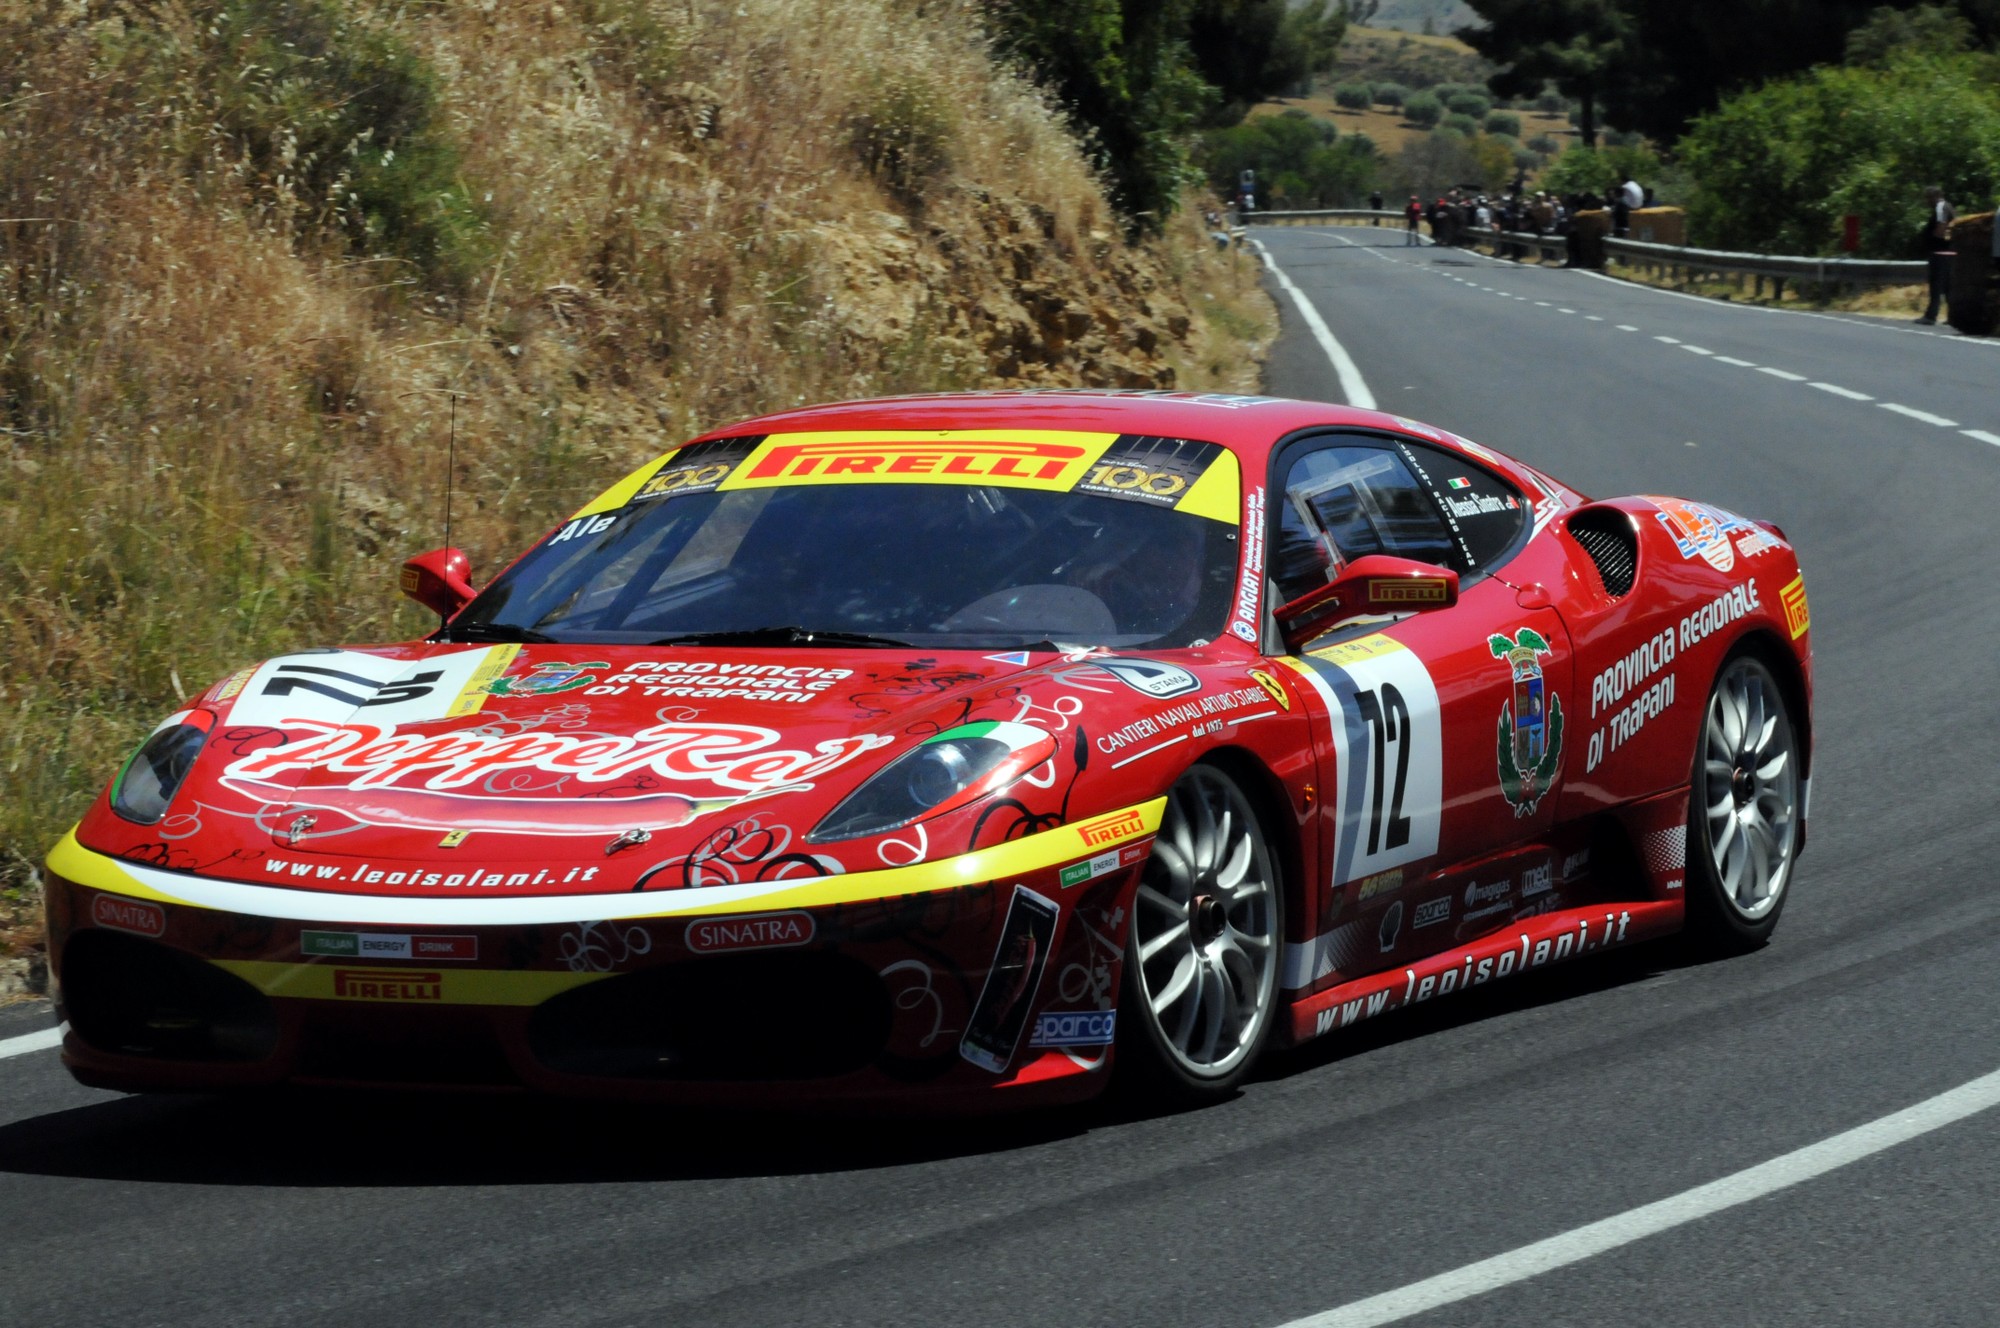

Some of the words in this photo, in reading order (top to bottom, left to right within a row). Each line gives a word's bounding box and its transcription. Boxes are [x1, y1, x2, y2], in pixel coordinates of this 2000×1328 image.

[745, 440, 1086, 480] PIRELLI
[643, 464, 731, 495] 100
[1080, 483, 1111, 493] YEARS
[1123, 490, 1174, 503] VICTORIES
[1089, 465, 1187, 495] 100
[1433, 491, 1460, 532] RACING
[1458, 537, 1476, 566] TEAM
[1372, 582, 1444, 599] PIRELLI
[1592, 626, 1675, 719] PROVINCIA
[1679, 577, 1760, 652] REGIONALE
[604, 673, 837, 691] REGIONALE
[623, 661, 854, 680] PROVINCIA
[1149, 675, 1189, 691] STAMA
[261, 665, 446, 708] 72
[583, 685, 630, 696] DI
[643, 685, 816, 703] TRAPANI
[1096, 717, 1160, 754] CANTIERI
[1155, 702, 1202, 729] NAVALI
[1201, 692, 1239, 716] ARTURO
[1234, 686, 1269, 706] STABILE
[1192, 723, 1206, 738] dal
[1205, 718, 1224, 735] 1875
[1586, 726, 1605, 774] DI
[1610, 673, 1675, 752] TRAPANI
[1353, 682, 1411, 857] 72
[1077, 810, 1144, 847] PIRELLI
[265, 858, 600, 887] www.leoisolani.it
[1065, 866, 1089, 881] ITALIAN
[1093, 857, 1117, 872] ENERGY
[1124, 848, 1141, 860] DRINK
[100, 900, 157, 930] SINATRA
[1415, 899, 1450, 923] sparco
[316, 937, 354, 949] ITALIAN
[363, 940, 406, 951] ENERGY
[419, 942, 455, 953] DRINK
[700, 919, 801, 946] SINATRA
[334, 969, 442, 1000] PIRELLI
[1316, 911, 1630, 1037] www.leoisolani.it
